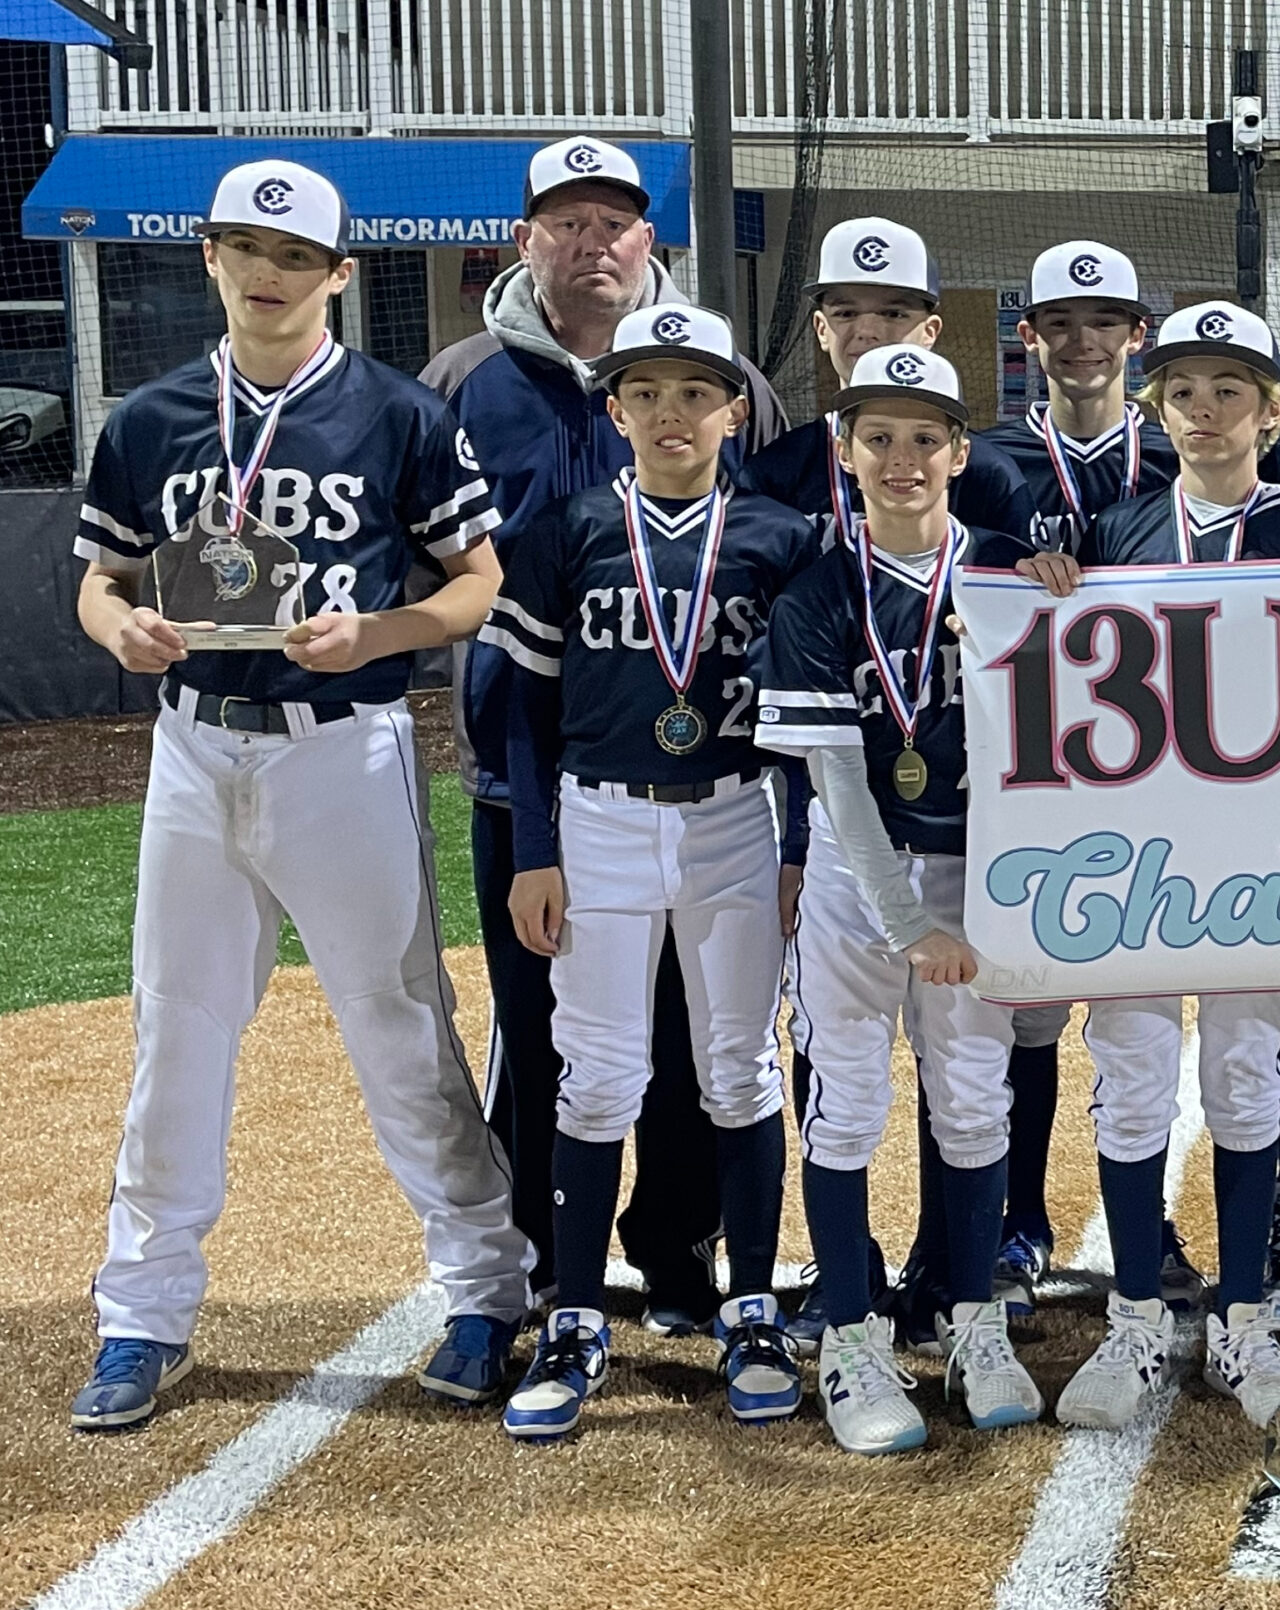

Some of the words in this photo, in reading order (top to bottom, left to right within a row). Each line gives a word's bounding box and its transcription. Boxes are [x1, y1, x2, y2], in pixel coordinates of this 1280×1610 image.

[348, 217, 515, 242] INFORMATI
[161, 466, 365, 543] CUBS
[269, 561, 358, 627] 78
[579, 587, 757, 657] CUBS
